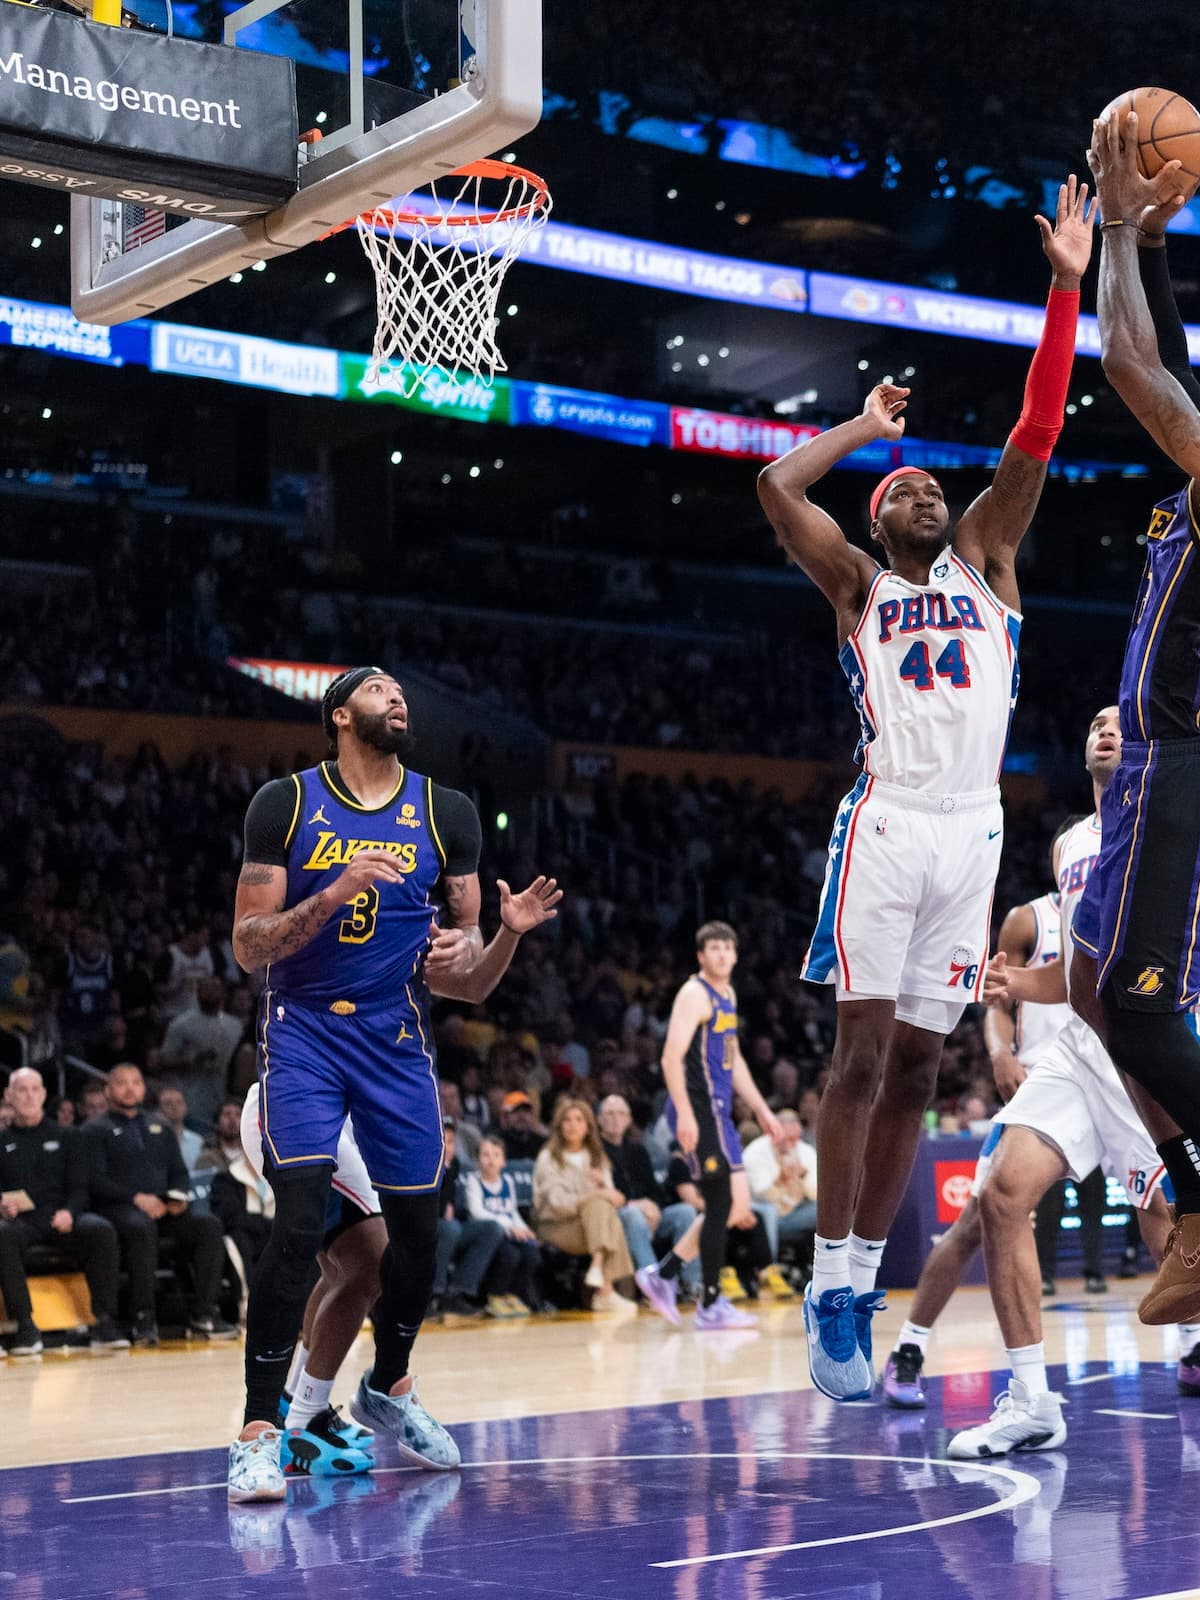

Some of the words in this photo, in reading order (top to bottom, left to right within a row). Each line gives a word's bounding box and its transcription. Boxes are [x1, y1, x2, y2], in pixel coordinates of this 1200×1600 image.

[0, 52, 242, 129] Management
[117, 189, 217, 213] DWS
[546, 232, 633, 272] TASTES
[635, 251, 687, 283] LIKE
[690, 262, 764, 296] TACOS
[915, 299, 1008, 334] VICTORY
[11, 325, 112, 358] EXPRESS
[174, 340, 234, 371] UCLA
[878, 592, 987, 644] PHILA
[899, 638, 971, 691] 44
[396, 816, 421, 829] bibigo
[338, 883, 380, 945] 3
[947, 963, 979, 990] 76
[1127, 1168, 1146, 1194] 76
